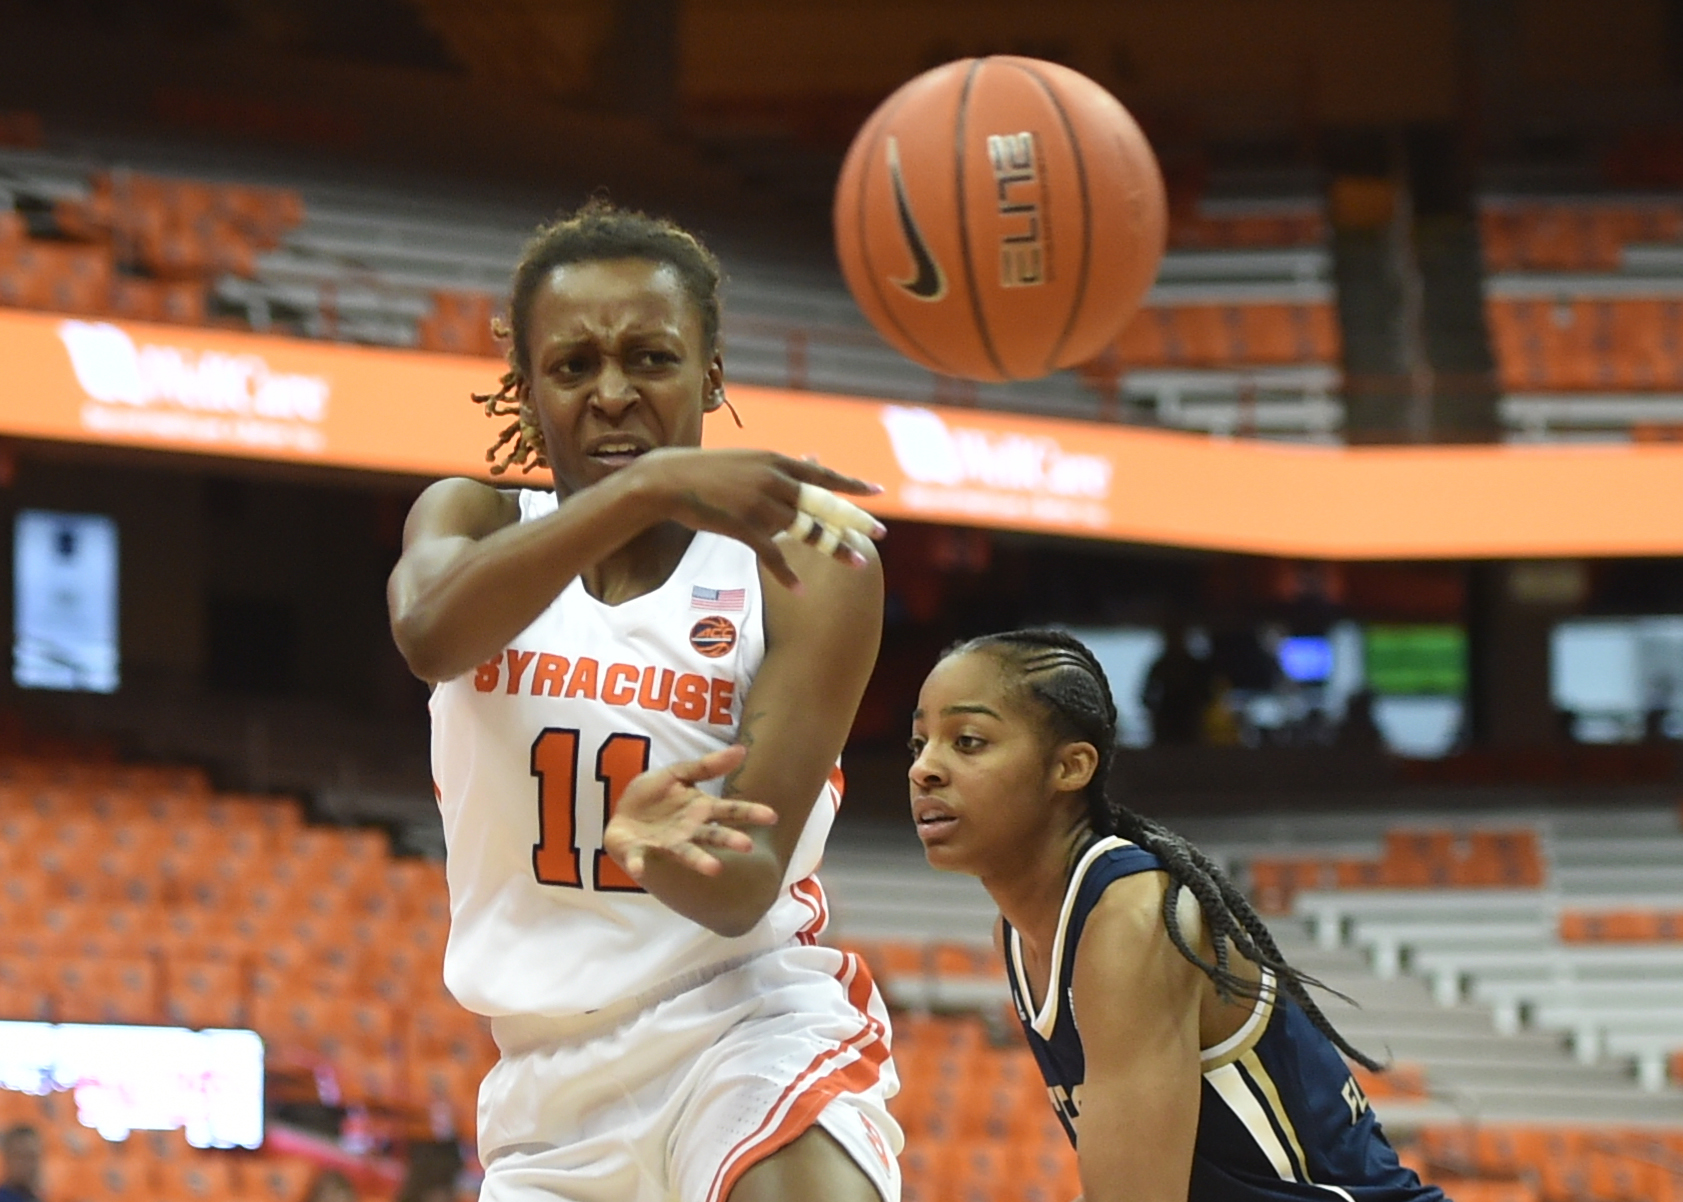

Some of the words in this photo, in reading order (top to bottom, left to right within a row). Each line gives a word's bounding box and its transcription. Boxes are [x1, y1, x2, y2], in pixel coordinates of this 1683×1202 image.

[987, 132, 1044, 287] ELITE
[474, 648, 735, 726] SYRACUSE
[696, 626, 733, 638] ACC
[530, 727, 651, 893] 11
